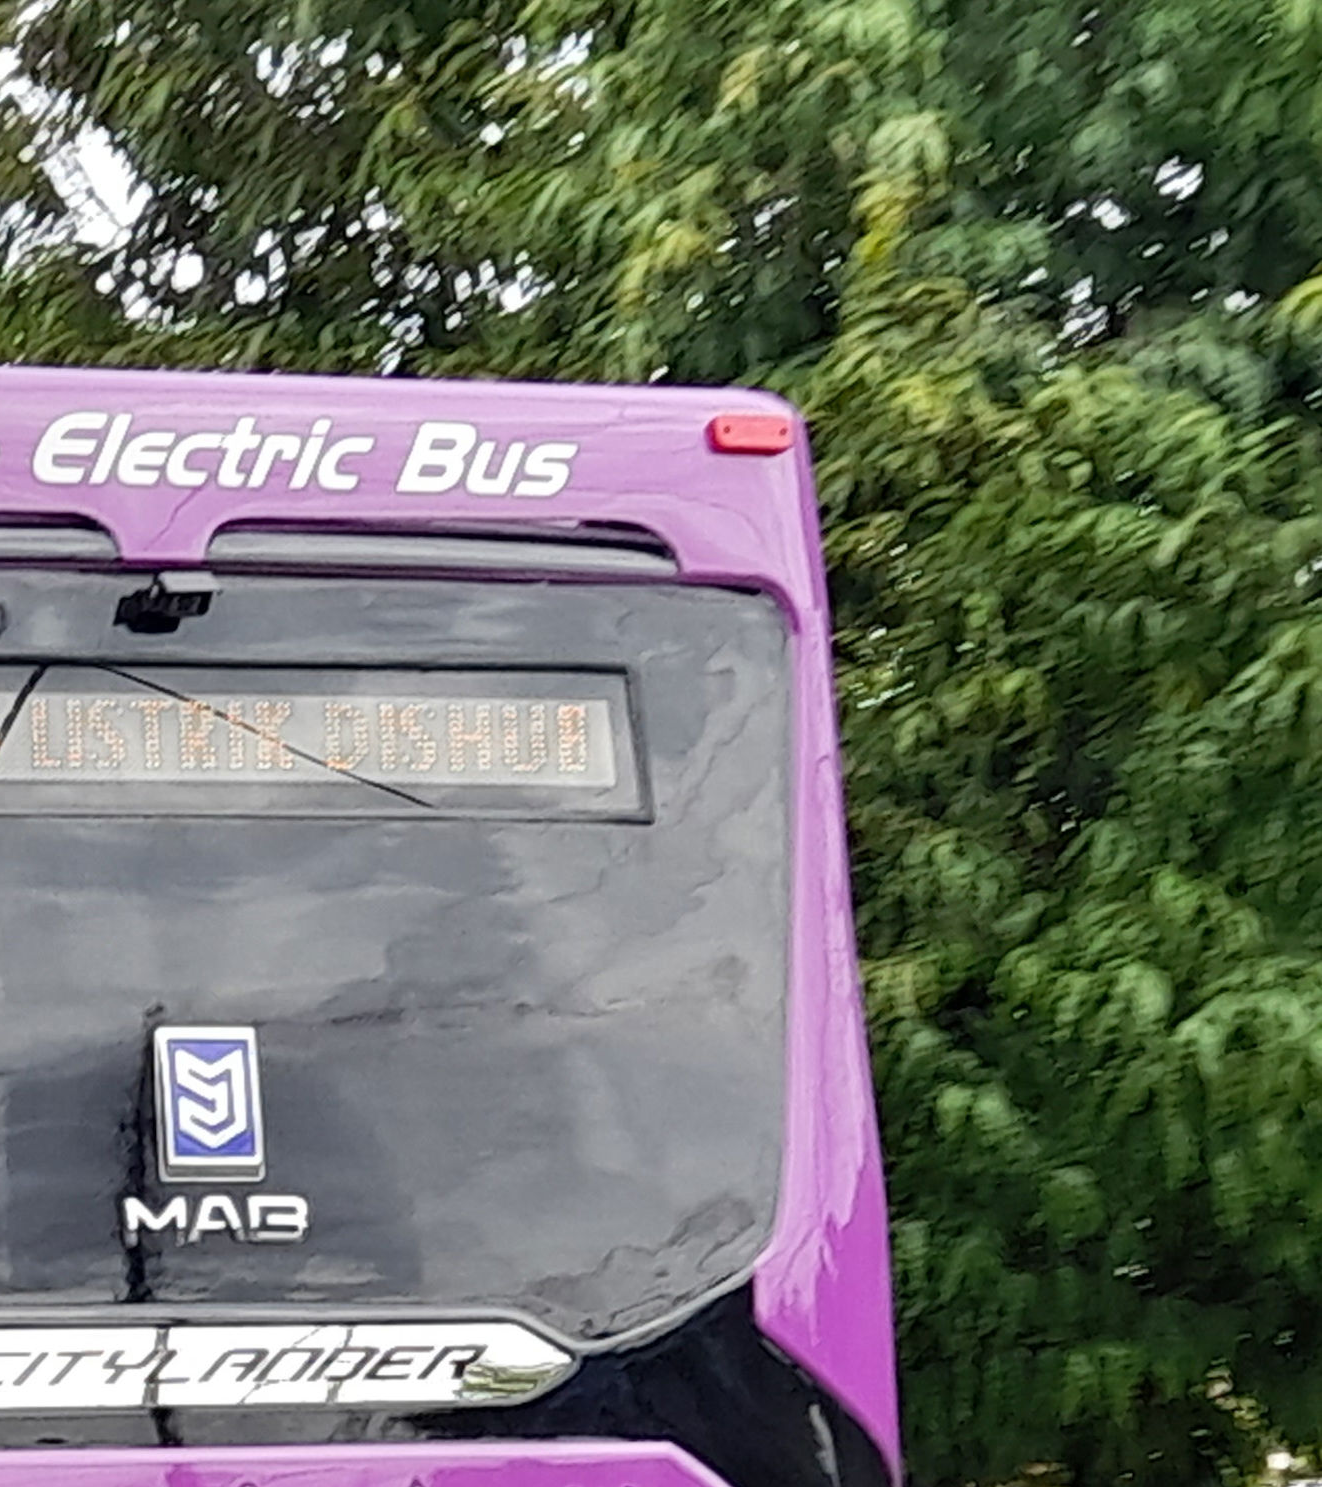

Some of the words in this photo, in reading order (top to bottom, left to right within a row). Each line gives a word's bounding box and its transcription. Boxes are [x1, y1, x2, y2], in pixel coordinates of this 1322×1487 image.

[31, 410, 375, 491] Electric
[394, 420, 579, 497] Bus
[31, 697, 295, 770] LISTRIK
[122, 1194, 310, 1248] MAB
